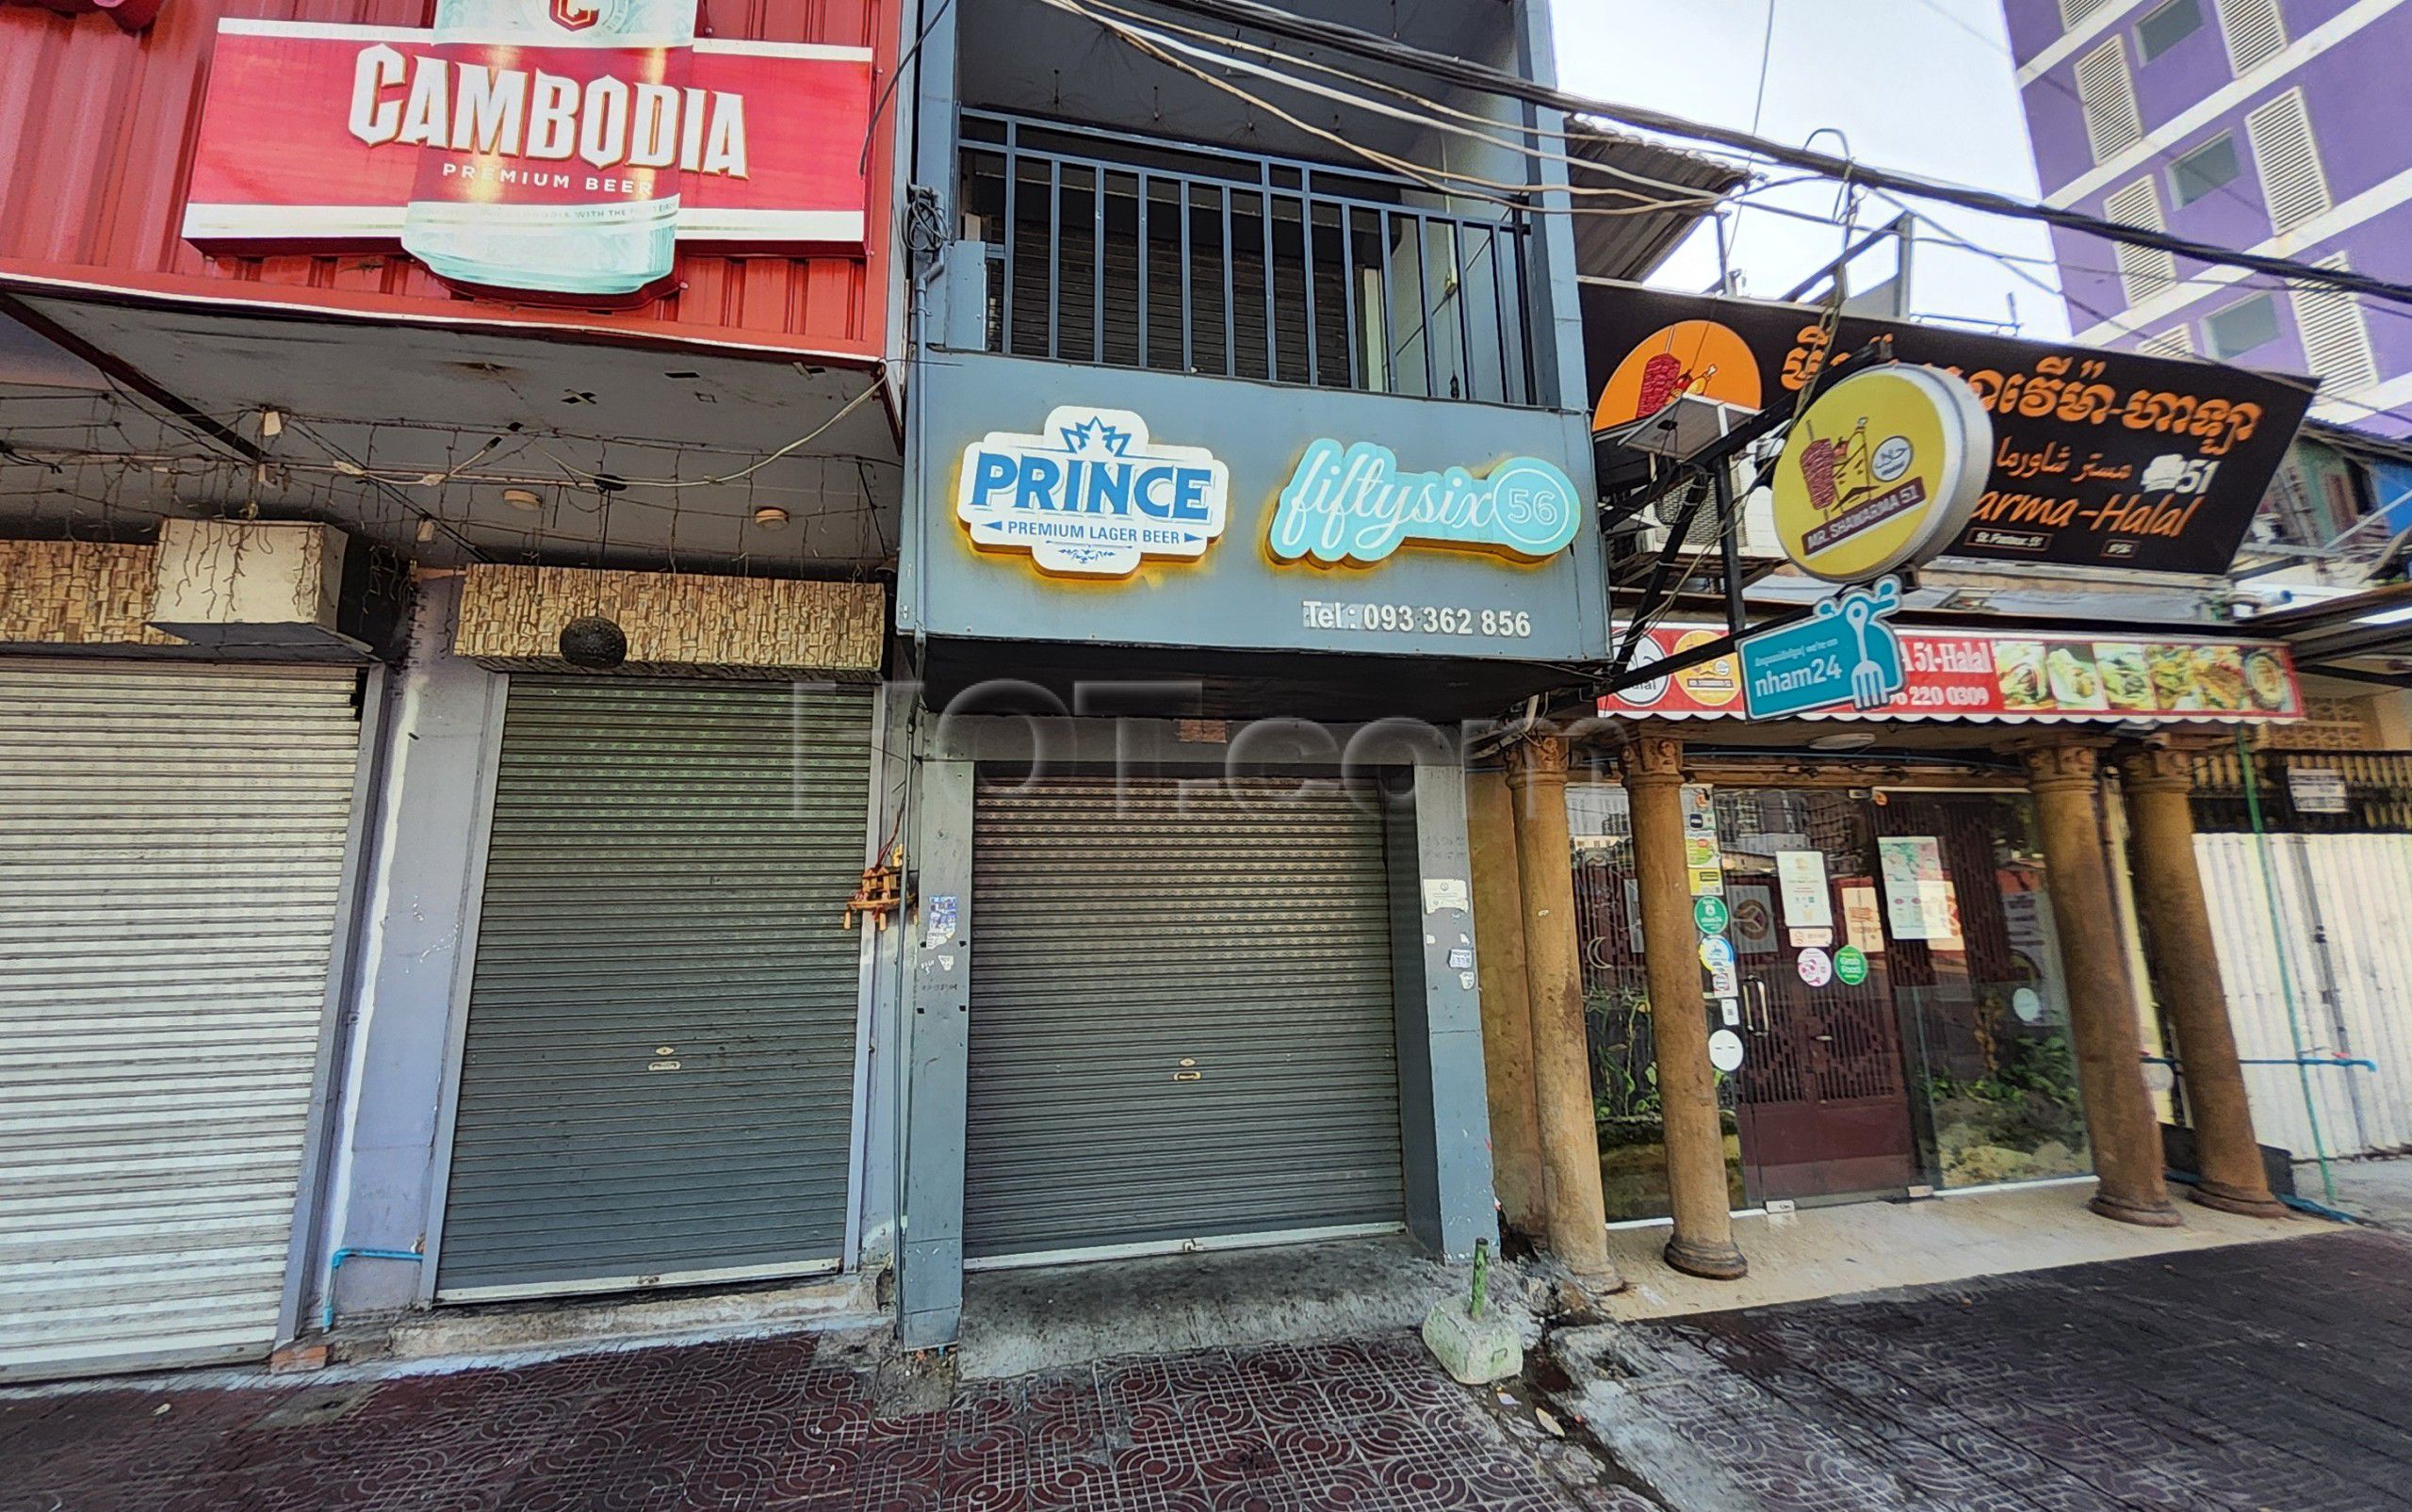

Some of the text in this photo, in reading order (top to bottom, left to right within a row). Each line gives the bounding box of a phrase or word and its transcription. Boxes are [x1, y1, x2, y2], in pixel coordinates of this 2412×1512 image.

[348, 42, 750, 180] CAMBODIA
[443, 162, 654, 194] PREMIUM BEER
[970, 450, 1213, 521] PRINCE
[2175, 458, 2221, 495] 51
[1282, 448, 1557, 549] fiftysix 56
[1007, 520, 1180, 544] PREMIUM LAGER BEER
[1363, 603, 1414, 631] 093
[1423, 606, 1474, 635] 362
[1481, 609, 1531, 637] 856
[1754, 654, 1844, 698] nham24
[1908, 685, 1945, 706] 220
